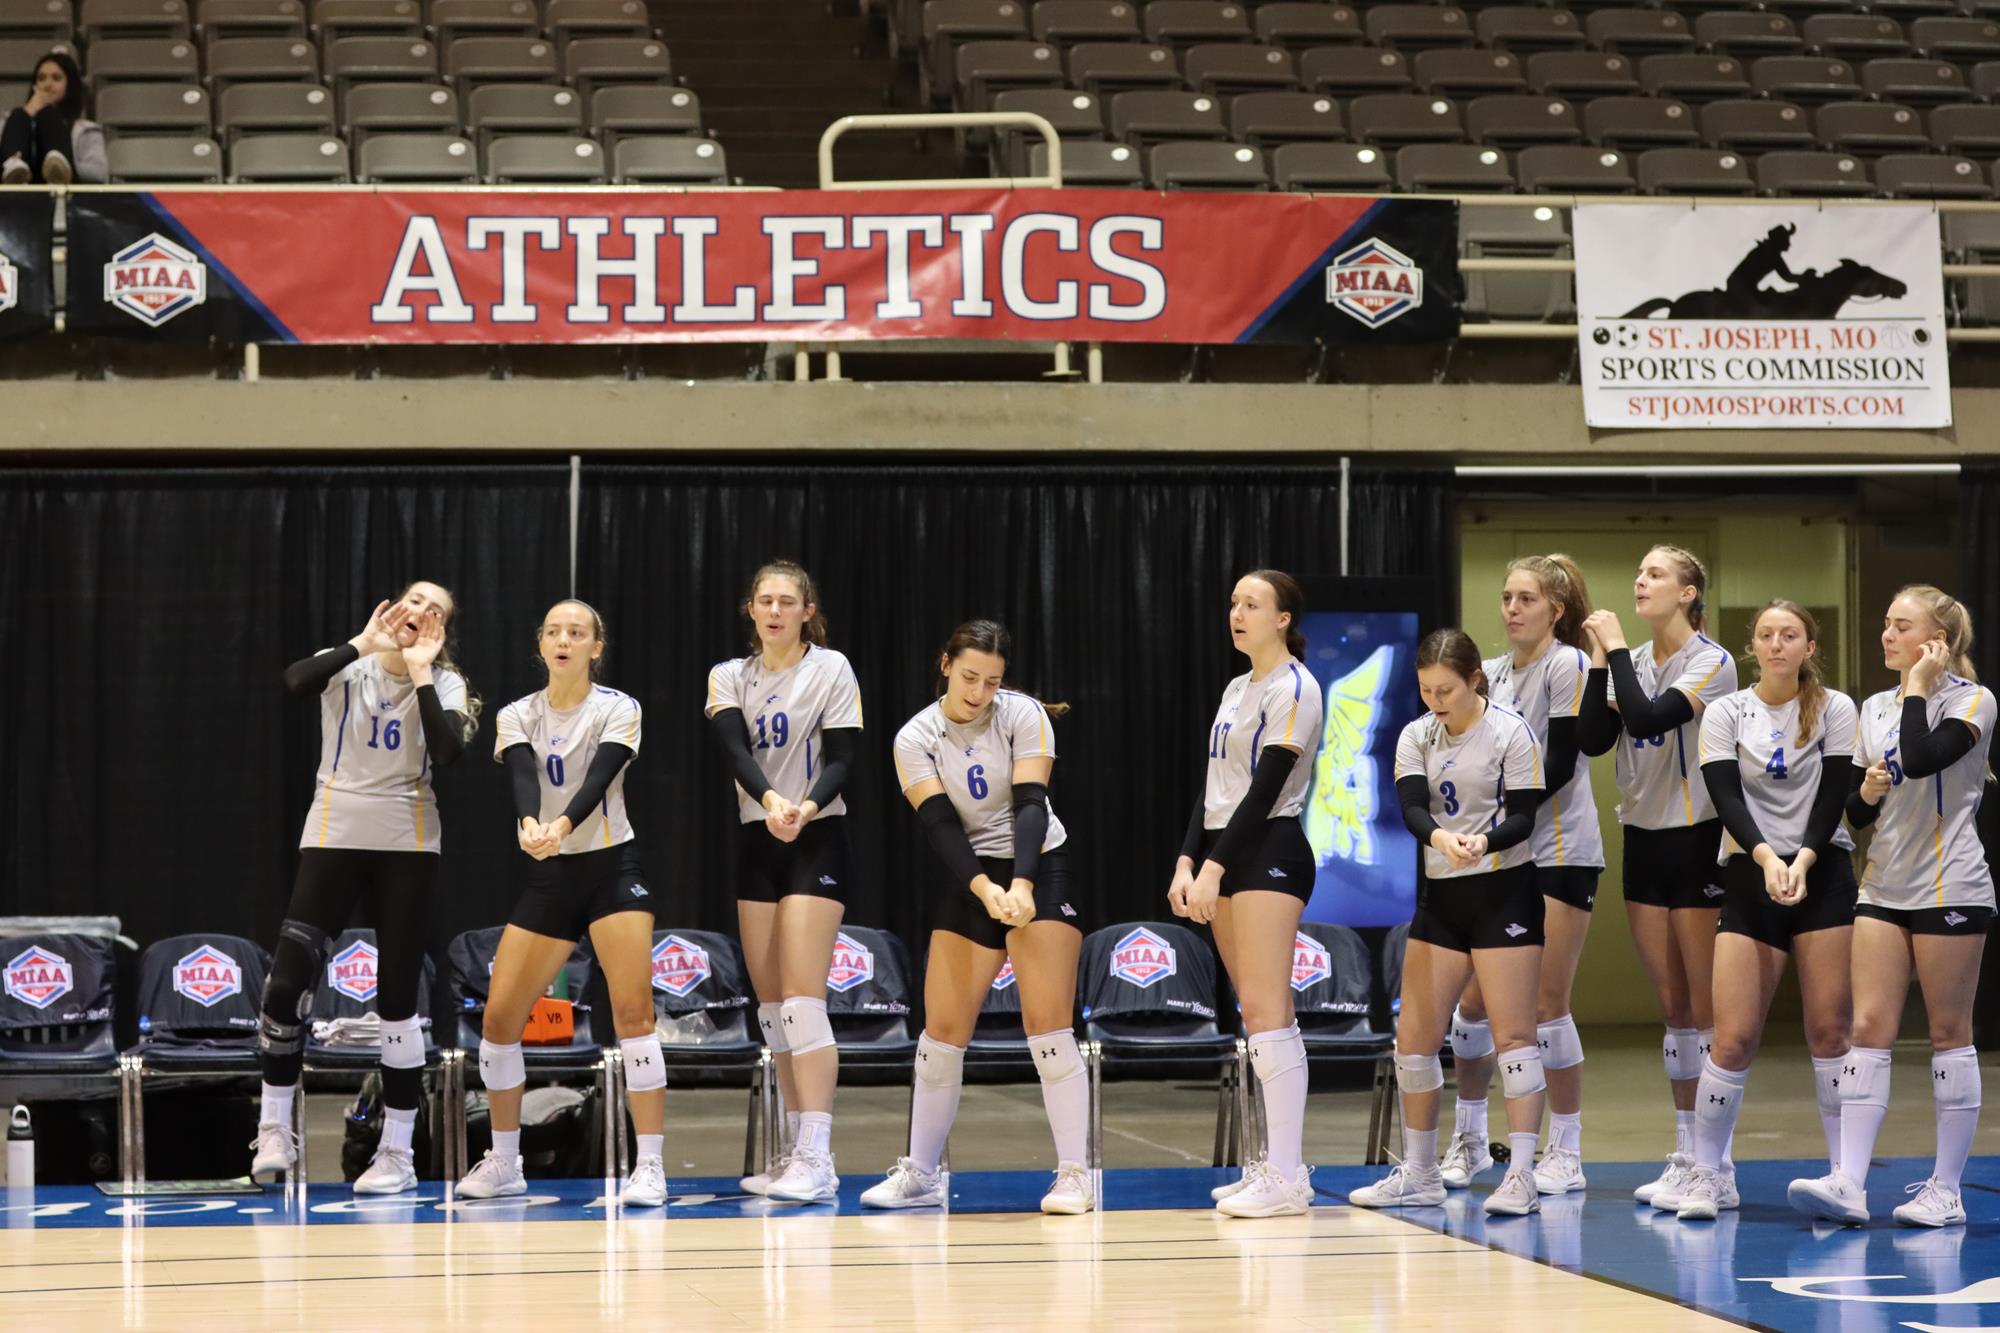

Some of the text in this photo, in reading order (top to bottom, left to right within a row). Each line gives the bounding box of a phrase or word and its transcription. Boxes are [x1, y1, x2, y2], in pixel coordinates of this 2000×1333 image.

[115, 266, 196, 290] MIAA
[370, 213, 1168, 323] ATHLETICS
[1335, 270, 1414, 295] MIAA
[1648, 327, 1877, 353] ST. JOSEPH, MO
[1601, 357, 1925, 381] SPORTS COMMISSION
[1628, 396, 1905, 421] STJOMOSPORTS.COM
[368, 715, 402, 751] 16
[756, 711, 788, 749] 19
[1210, 722, 1233, 759] 17
[546, 753, 565, 787] 0
[1766, 747, 1787, 780] 4
[967, 764, 989, 800] 6
[1440, 780, 1459, 816] 3
[652, 955, 705, 977] MIAA
[832, 953, 867, 971] IAA
[1116, 948, 1170, 968] MIAA
[10, 968, 66, 986] MIAA
[180, 967, 236, 985] MIAA
[335, 963, 374, 981] MIA
